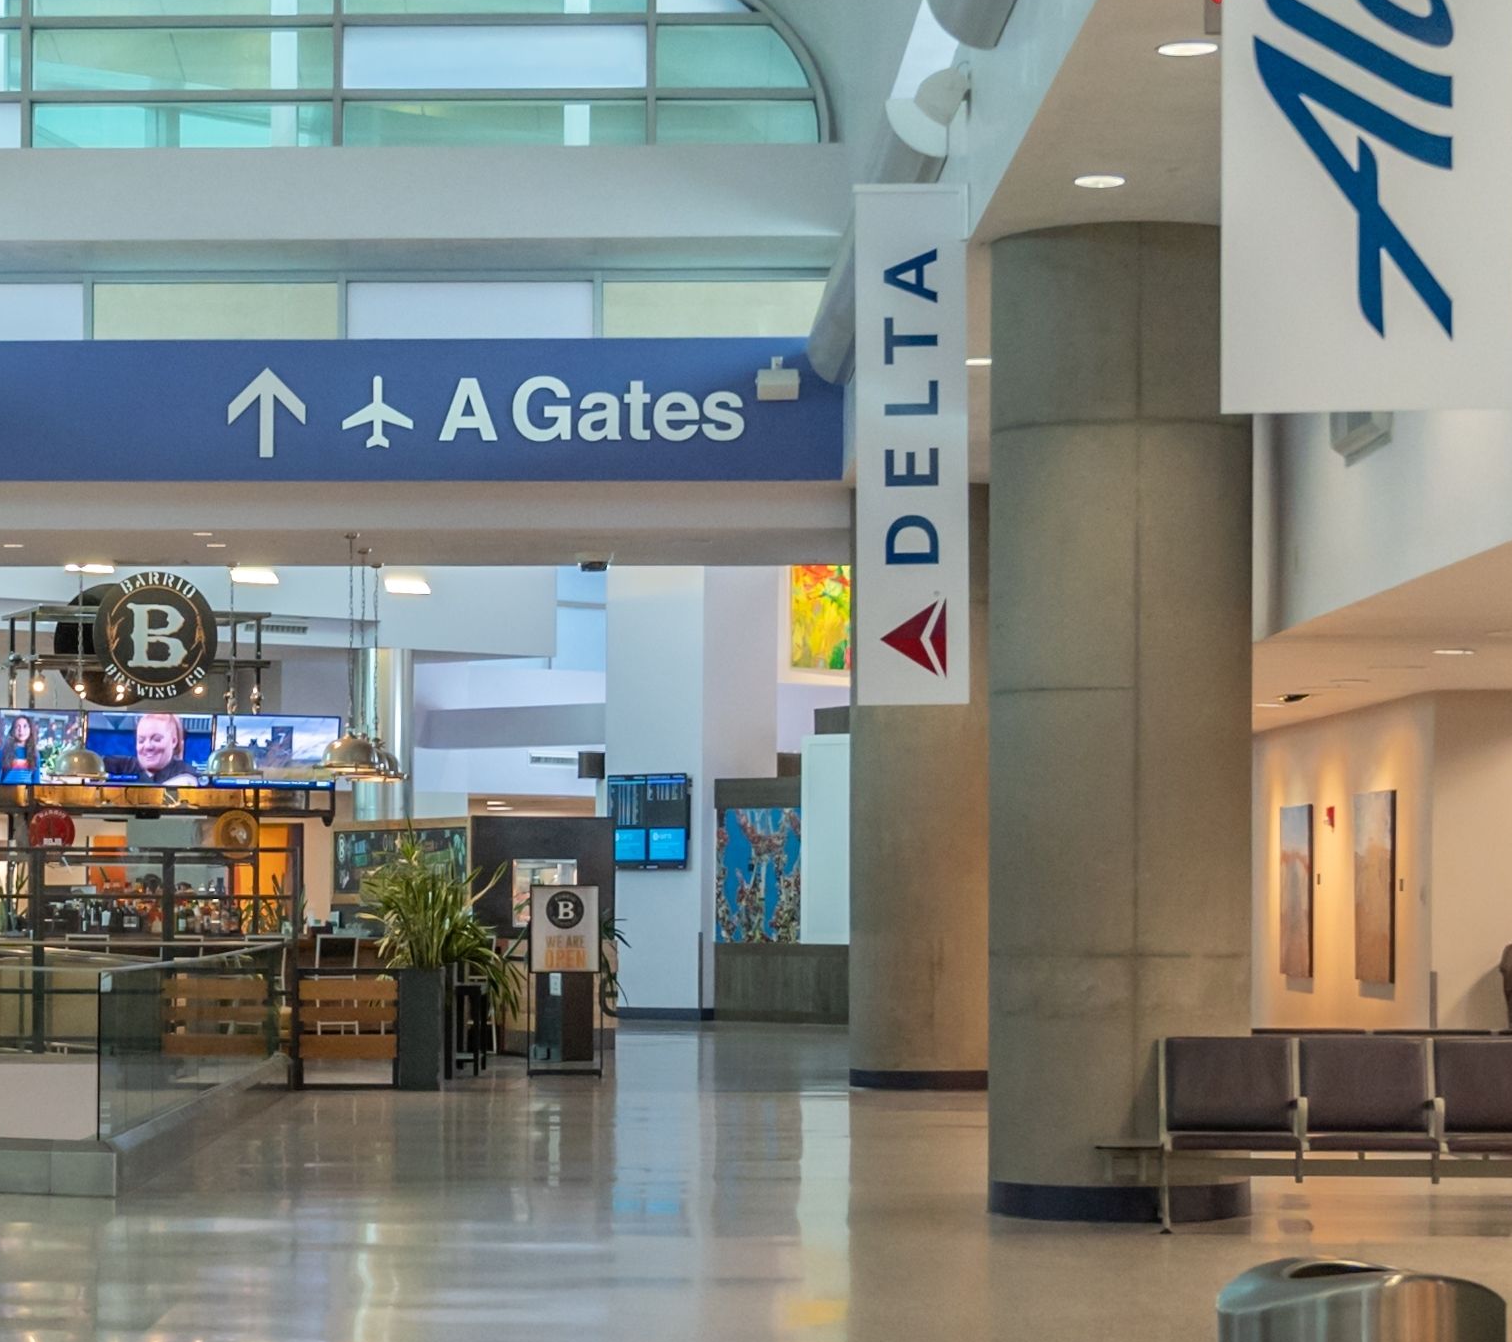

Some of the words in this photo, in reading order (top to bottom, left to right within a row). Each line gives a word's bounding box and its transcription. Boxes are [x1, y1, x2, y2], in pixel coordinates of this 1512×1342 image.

[439, 377, 498, 441] A
[511, 376, 745, 442] Gates
[883, 247, 940, 565] DELTA
[120, 571, 196, 599] BARRIO
[126, 602, 188, 668] B
[105, 663, 177, 698] BREWING
[185, 666, 206, 687] CO
[557, 901, 575, 920] B
[545, 949, 587, 969] OPEN
